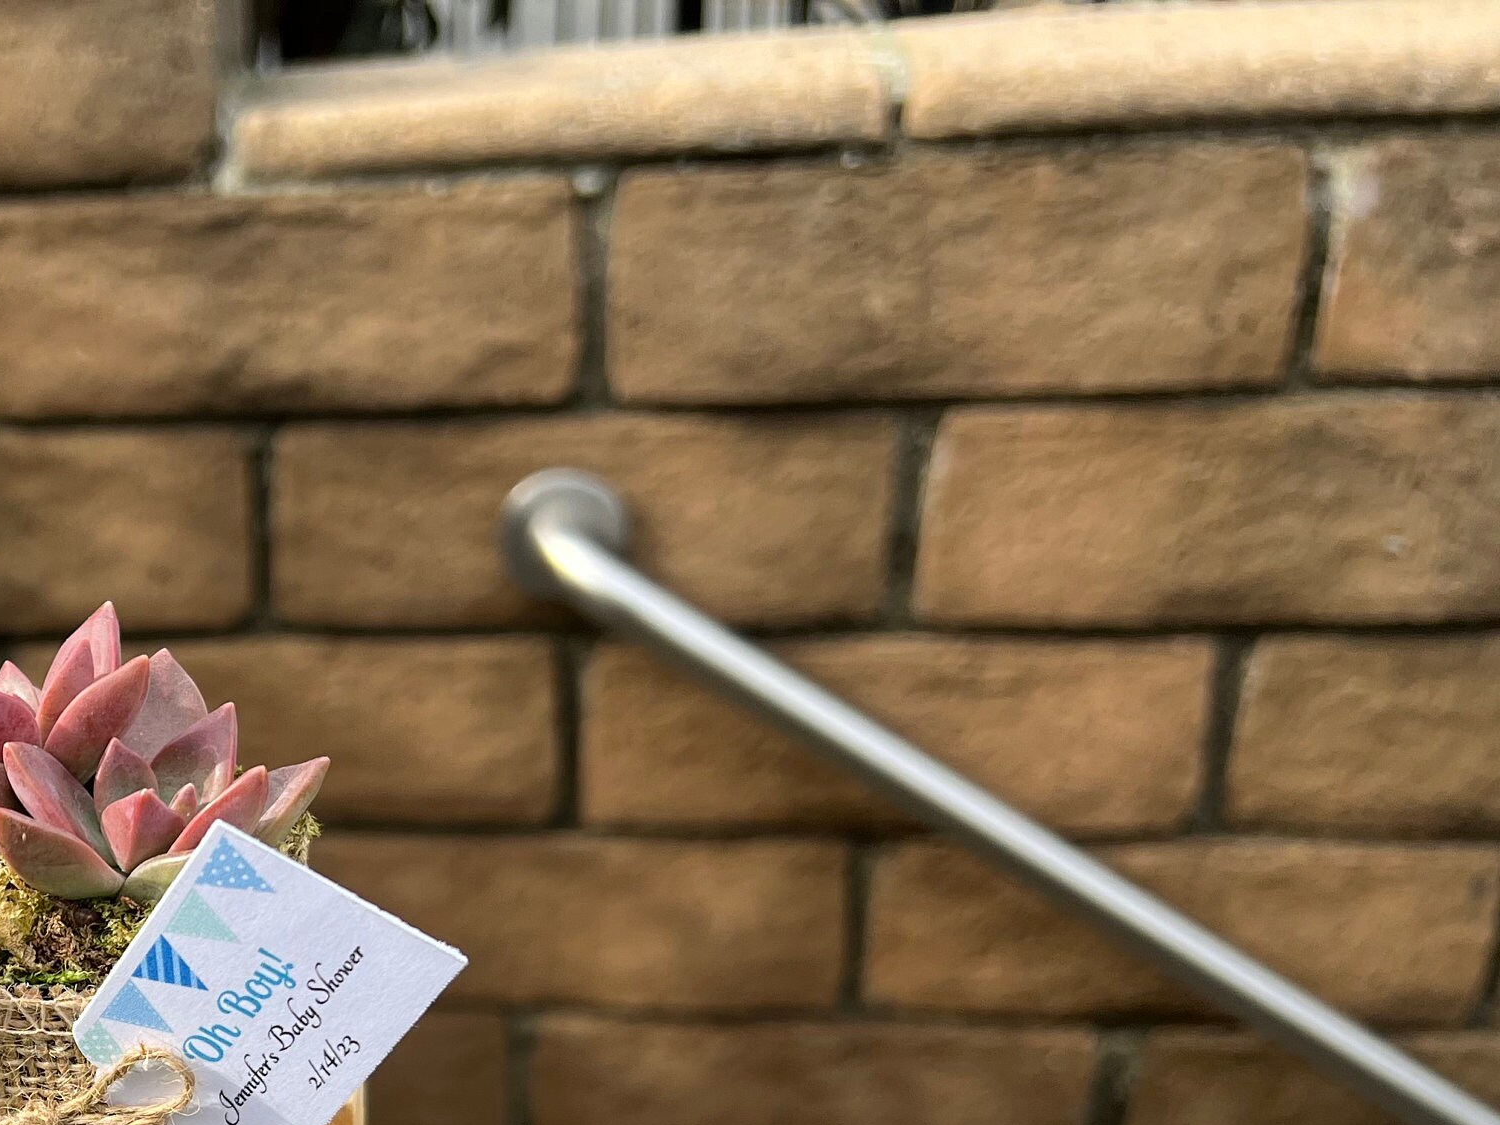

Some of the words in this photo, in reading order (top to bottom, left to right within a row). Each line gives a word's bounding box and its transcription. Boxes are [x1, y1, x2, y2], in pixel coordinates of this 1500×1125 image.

[182, 1020, 241, 1063] Oh
[220, 947, 297, 1018] Boy!
[268, 998, 322, 1051] Baby
[307, 946, 365, 1005] Shower
[308, 1035, 361, 1091] 2/14/23
